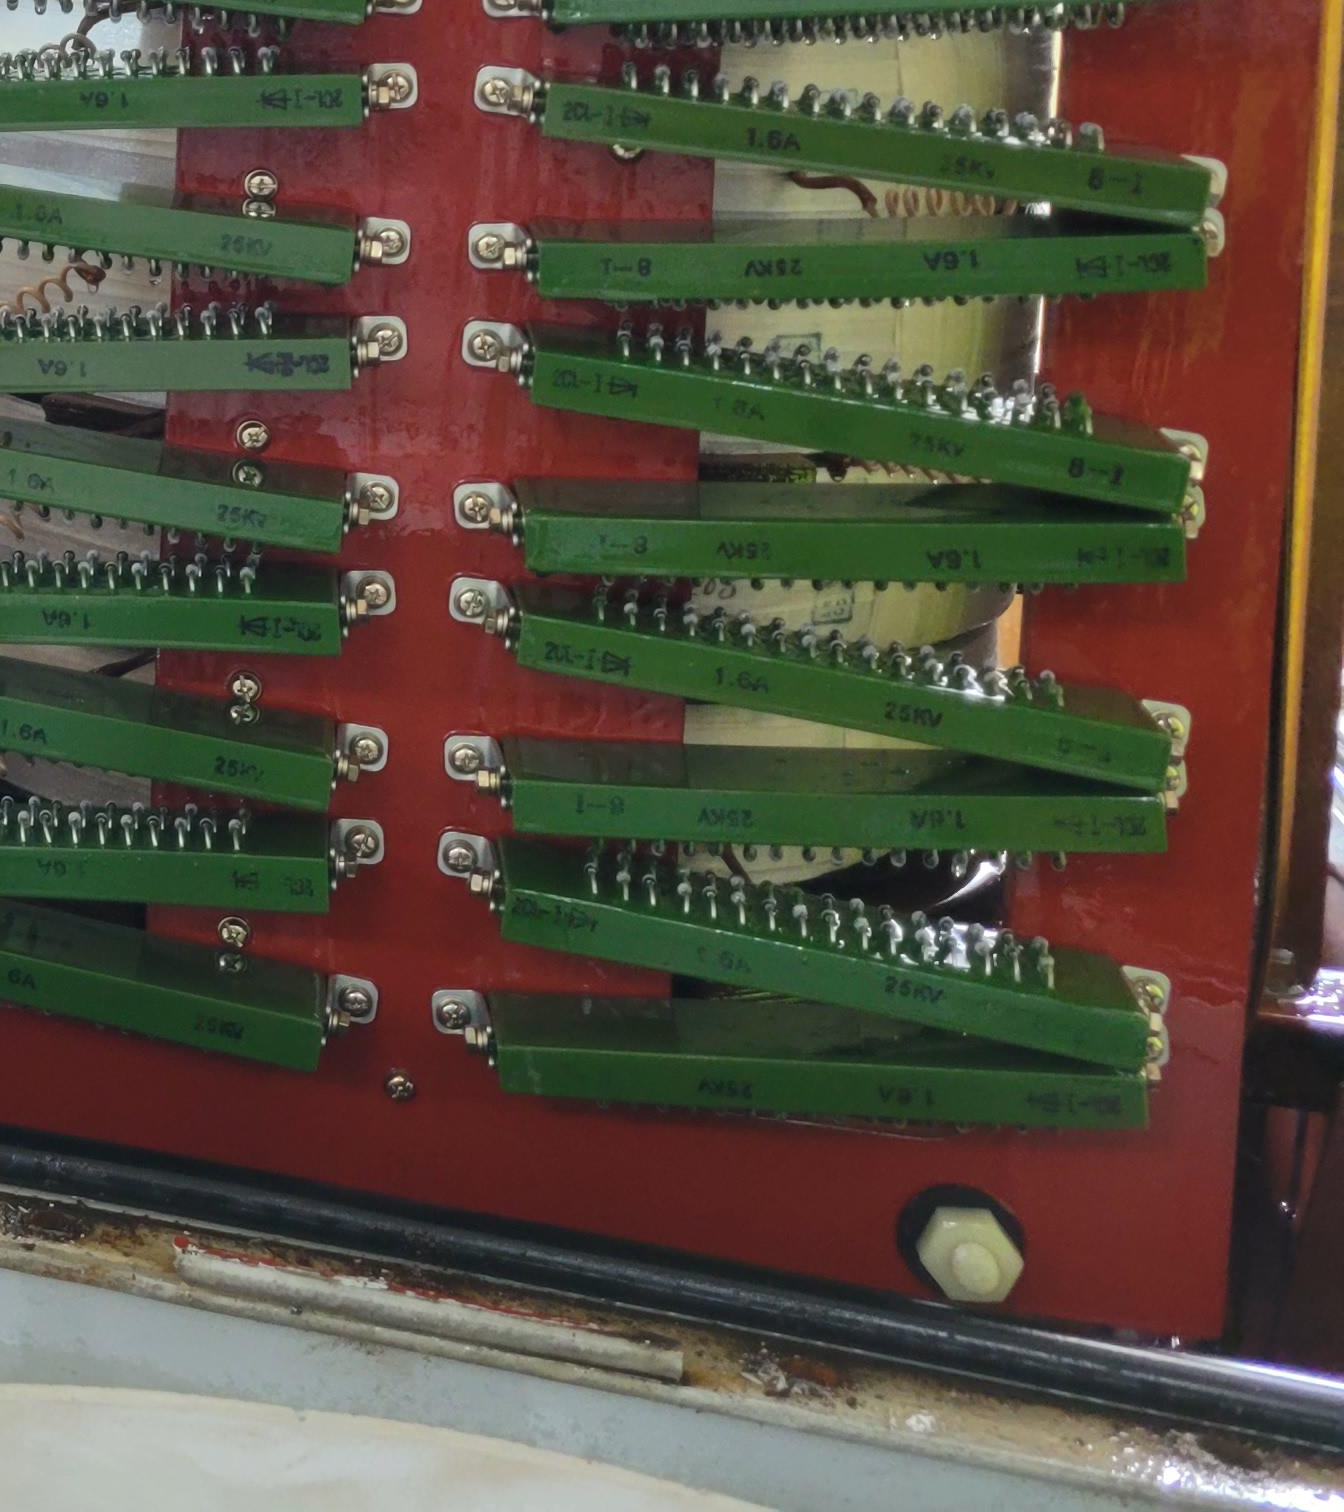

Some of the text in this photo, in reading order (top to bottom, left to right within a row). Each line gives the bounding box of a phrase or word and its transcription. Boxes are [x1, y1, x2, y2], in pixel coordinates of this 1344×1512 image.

[744, 126, 802, 154] 1.6A
[743, 257, 801, 277] 25KV
[922, 250, 977, 270] 1.6A
[38, 358, 85, 377] 1.6A
[925, 548, 981, 569] 1.6A
[882, 699, 943, 730] 25KV
